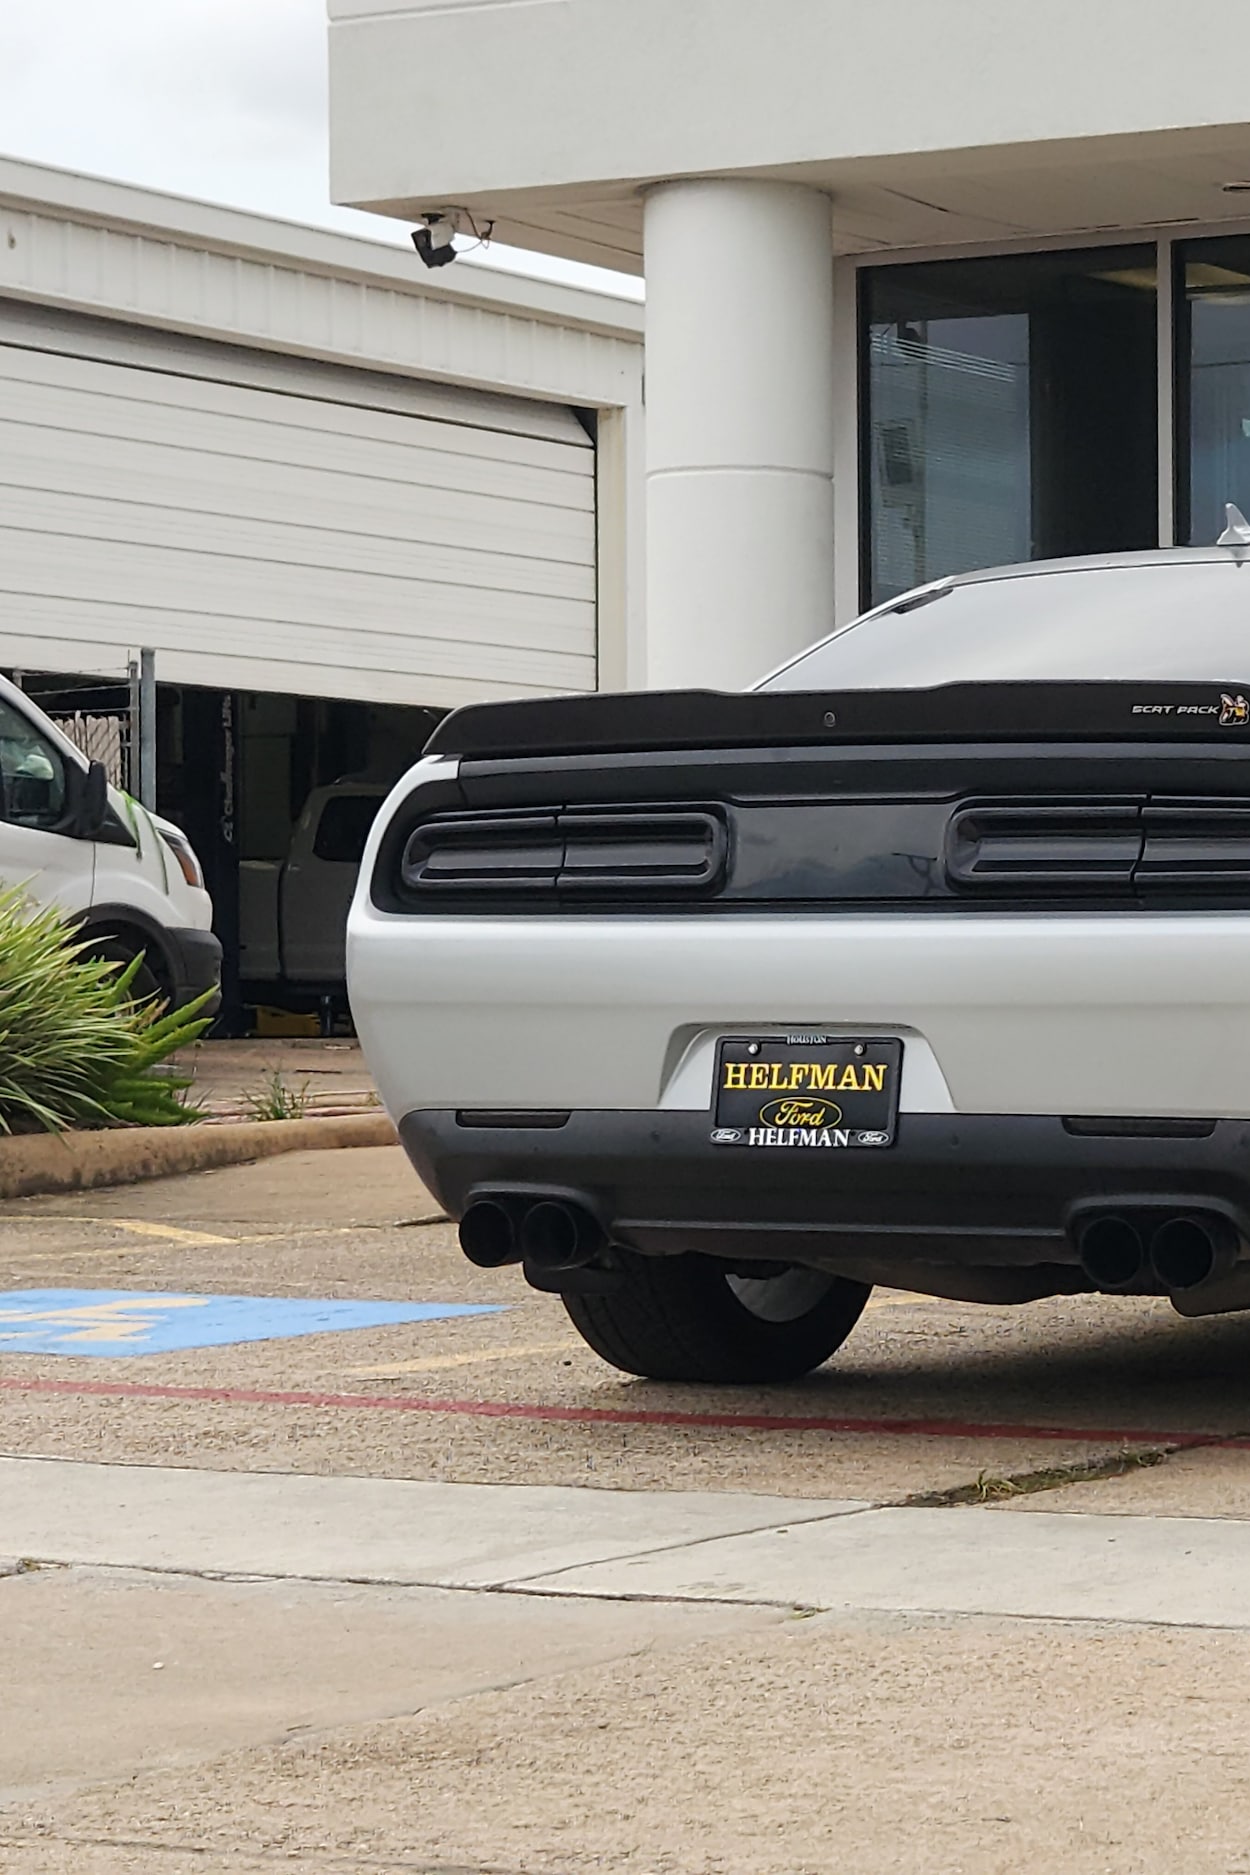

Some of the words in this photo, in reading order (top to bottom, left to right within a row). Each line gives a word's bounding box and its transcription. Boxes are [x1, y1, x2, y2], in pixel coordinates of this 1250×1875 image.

[1132, 705, 1174, 714] SCAT
[1176, 705, 1220, 714] PACK
[723, 1062, 888, 1091] HELFMAN
[774, 1100, 826, 1126] Ford
[749, 1128, 852, 1148] HELFMAN
